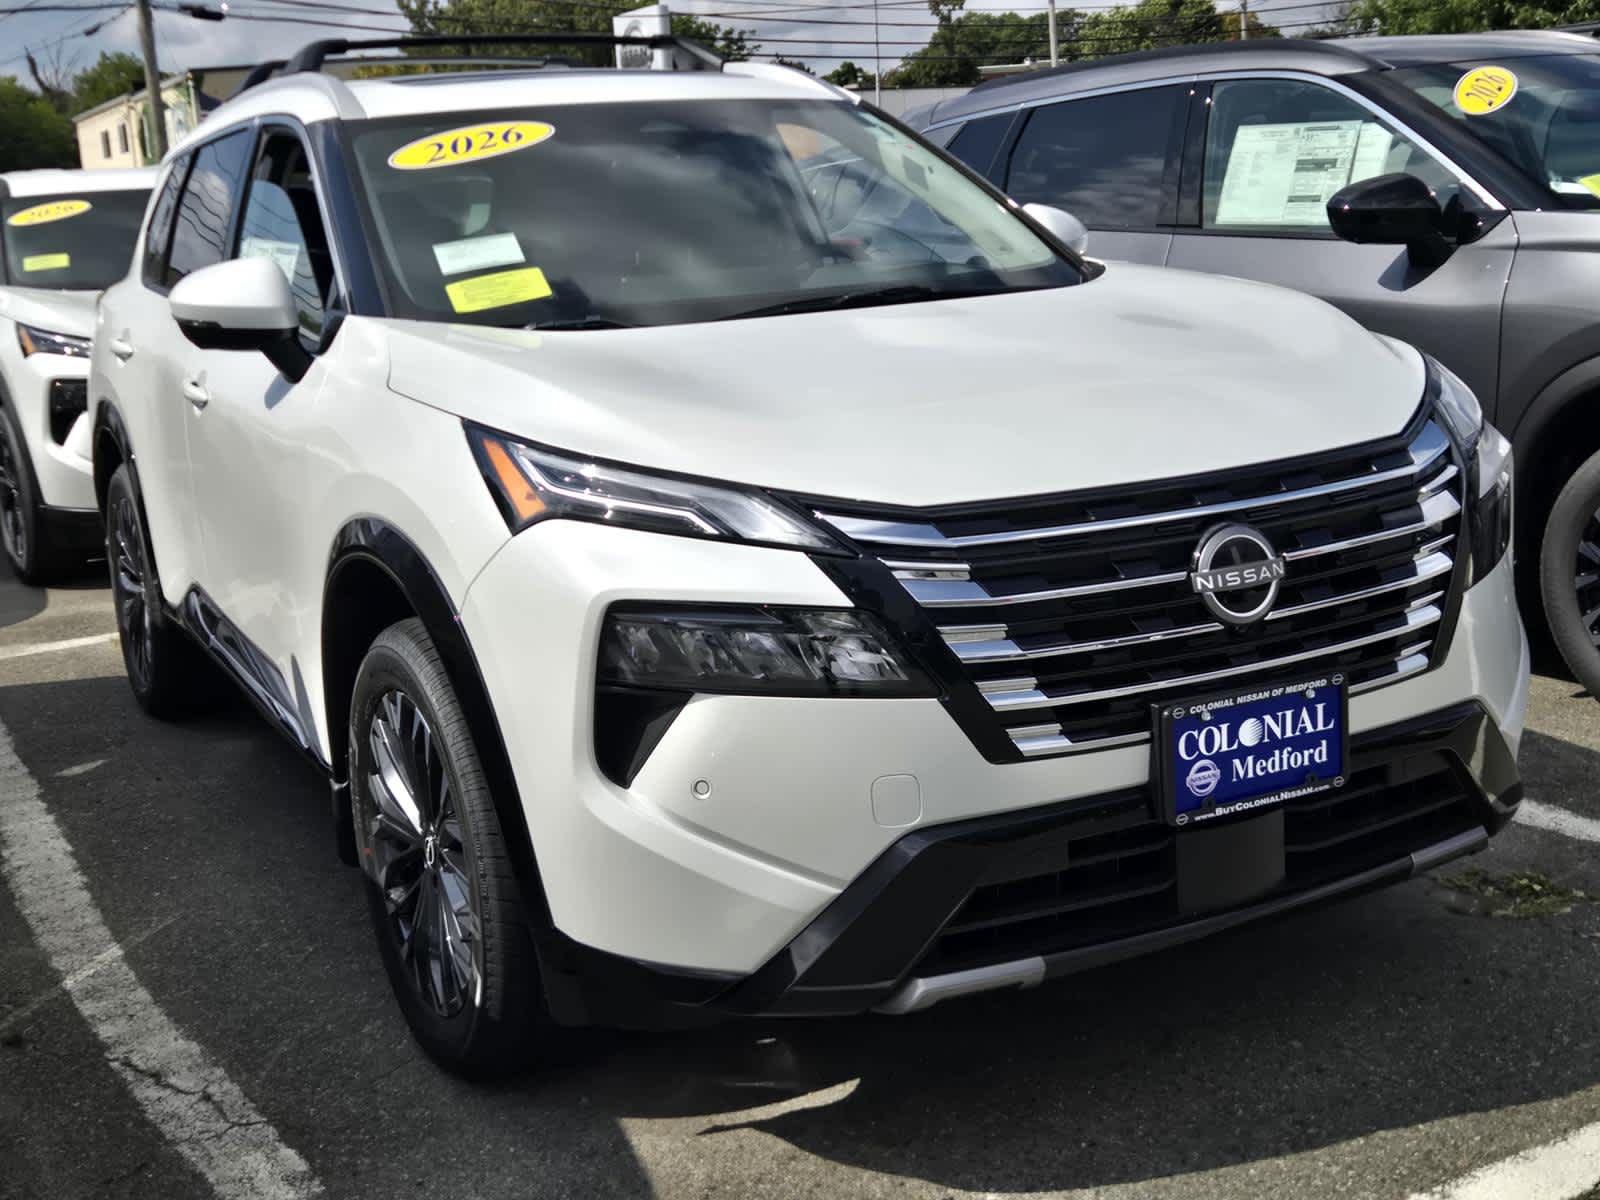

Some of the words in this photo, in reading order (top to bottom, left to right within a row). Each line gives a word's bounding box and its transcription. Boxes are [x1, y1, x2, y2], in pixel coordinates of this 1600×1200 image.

[1465, 71, 1507, 107] 2026
[425, 123, 524, 165] 2026
[1195, 560, 1285, 591] NISSAN
[1189, 698, 1235, 715] COLONIAL
[1236, 690, 1271, 704] NISSAN
[1271, 687, 1285, 697] OF
[1284, 679, 1328, 695] MEDFORD
[1177, 702, 1335, 761] COLONIAL
[1231, 739, 1328, 782] Medford
